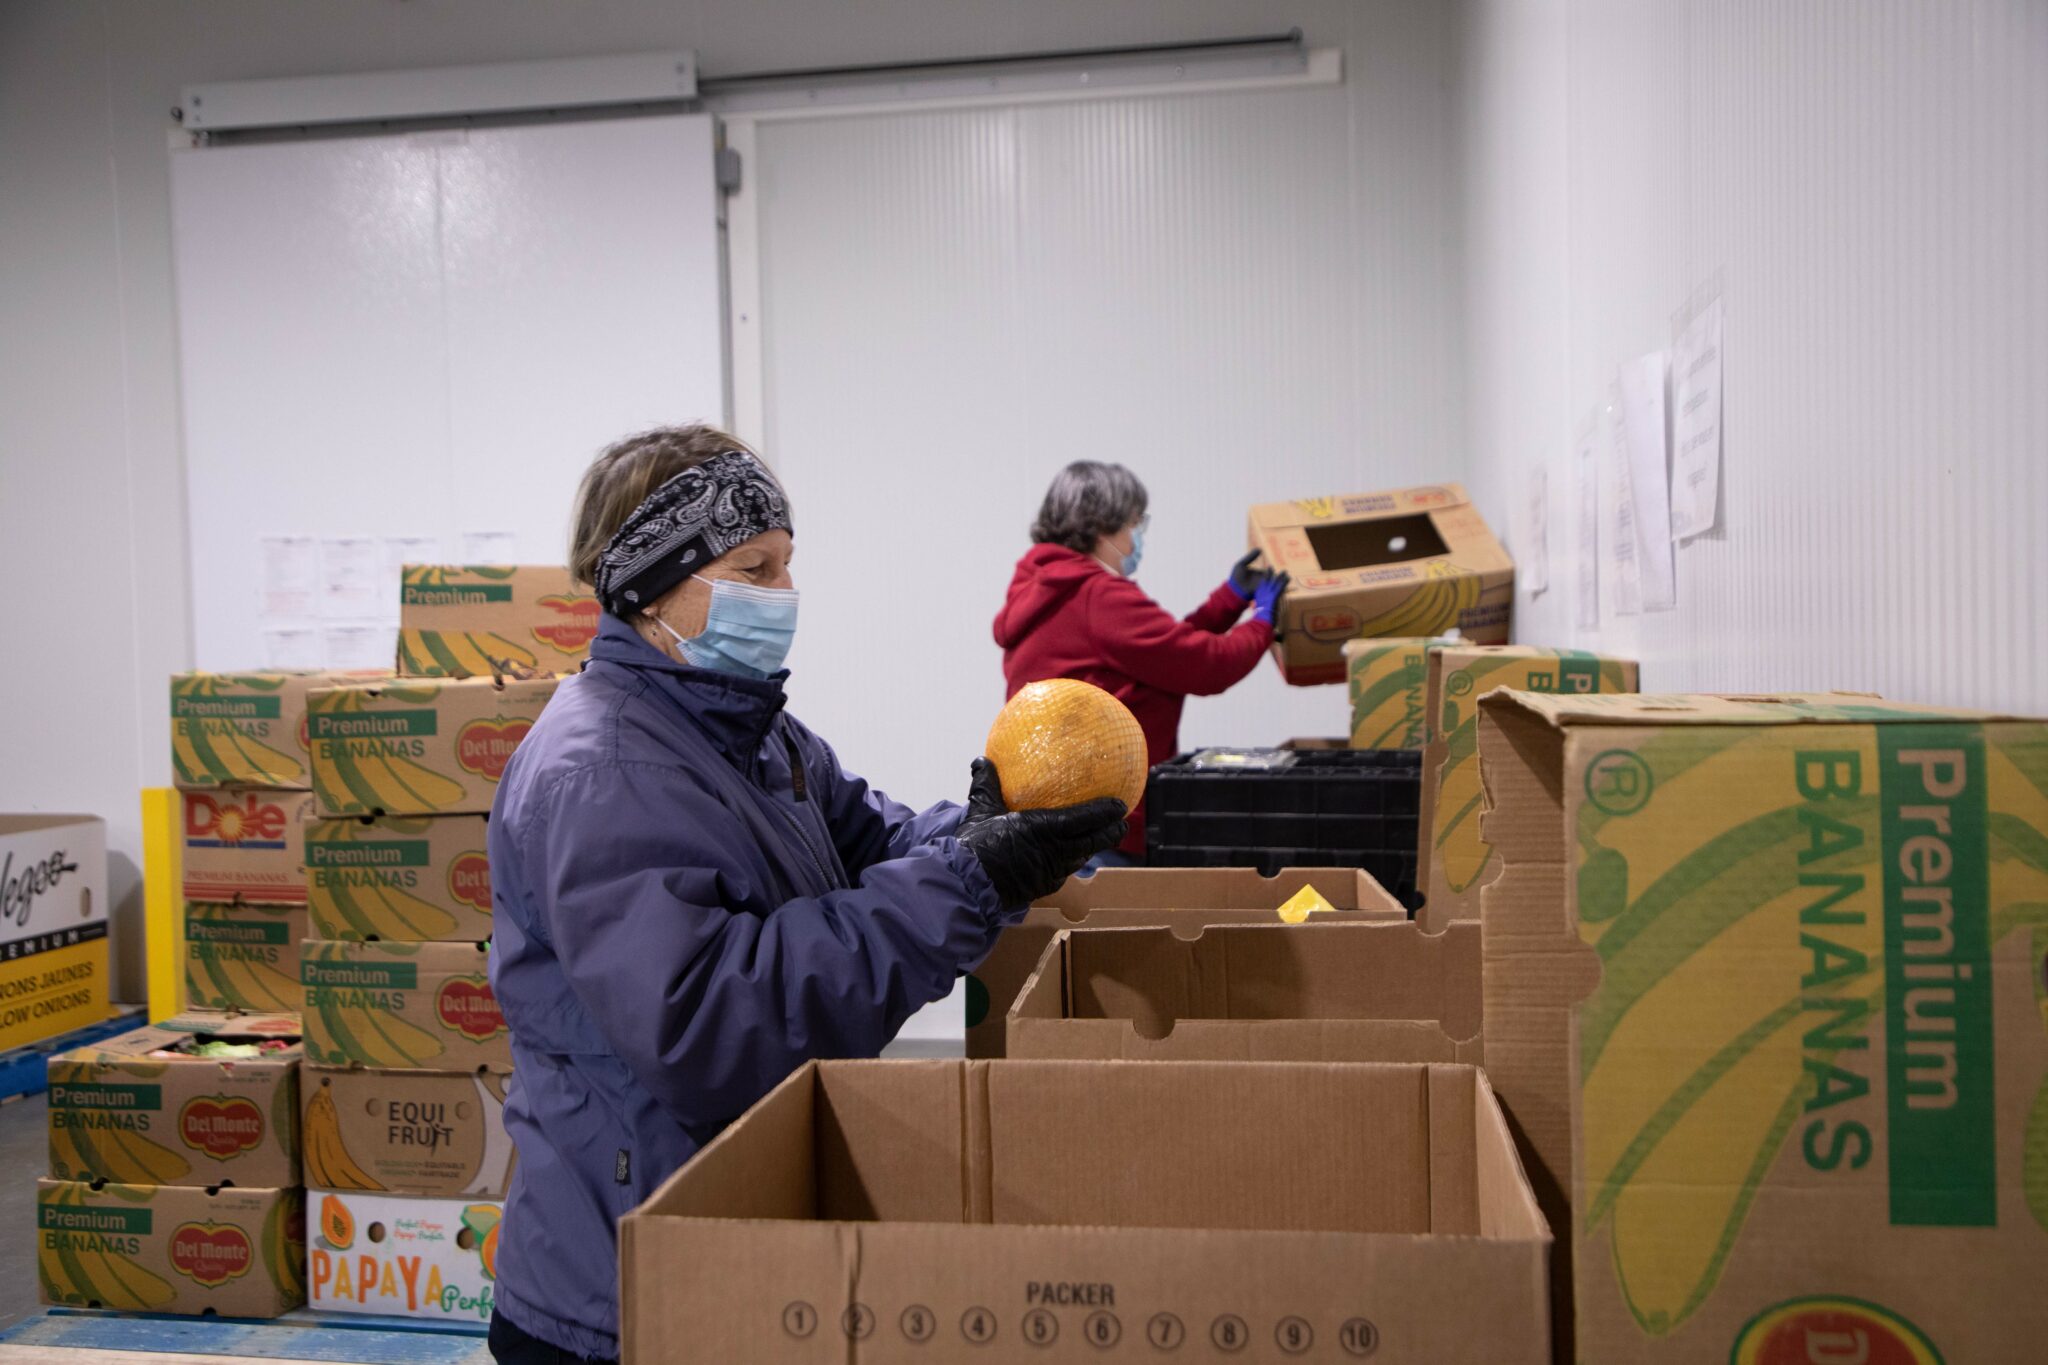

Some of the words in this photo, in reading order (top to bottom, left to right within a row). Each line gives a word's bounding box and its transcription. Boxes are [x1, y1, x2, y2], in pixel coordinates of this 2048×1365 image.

[405, 587, 487, 605] Premium
[177, 698, 257, 715] Premium
[1405, 654, 1425, 748] BANANA
[178, 720, 270, 737] BNANAS
[317, 716, 409, 735] Premium
[320, 738, 425, 760] BANANAS
[464, 739, 488, 757] Del
[185, 792, 287, 840] Dole
[312, 845, 402, 864] Premium
[315, 870, 418, 888] BANANAS
[190, 922, 266, 941] Premium
[1896, 748, 1975, 1112] Premium
[0, 929, 79, 960] EMIUM
[1793, 748, 1873, 1173] BANANAS
[40, 960, 94, 989] JAUNES
[305, 964, 391, 985] Premium
[32, 987, 91, 1018] ONIONS
[305, 990, 405, 1011] BANANAS
[443, 994, 467, 1012] Del
[468, 995, 501, 1012] Mon
[51, 1087, 136, 1106] Premium
[53, 1112, 150, 1131] BANANAS
[388, 1101, 446, 1125] EQUI
[187, 1115, 211, 1132] Del
[212, 1116, 259, 1133] Monte
[44, 1208, 127, 1230] Premium
[45, 1233, 140, 1256] BANANAS
[175, 1240, 198, 1258] Del
[200, 1242, 248, 1260] Monte
[311, 1249, 444, 1312] PAPAYA
[1026, 1281, 1116, 1306] PACKER
